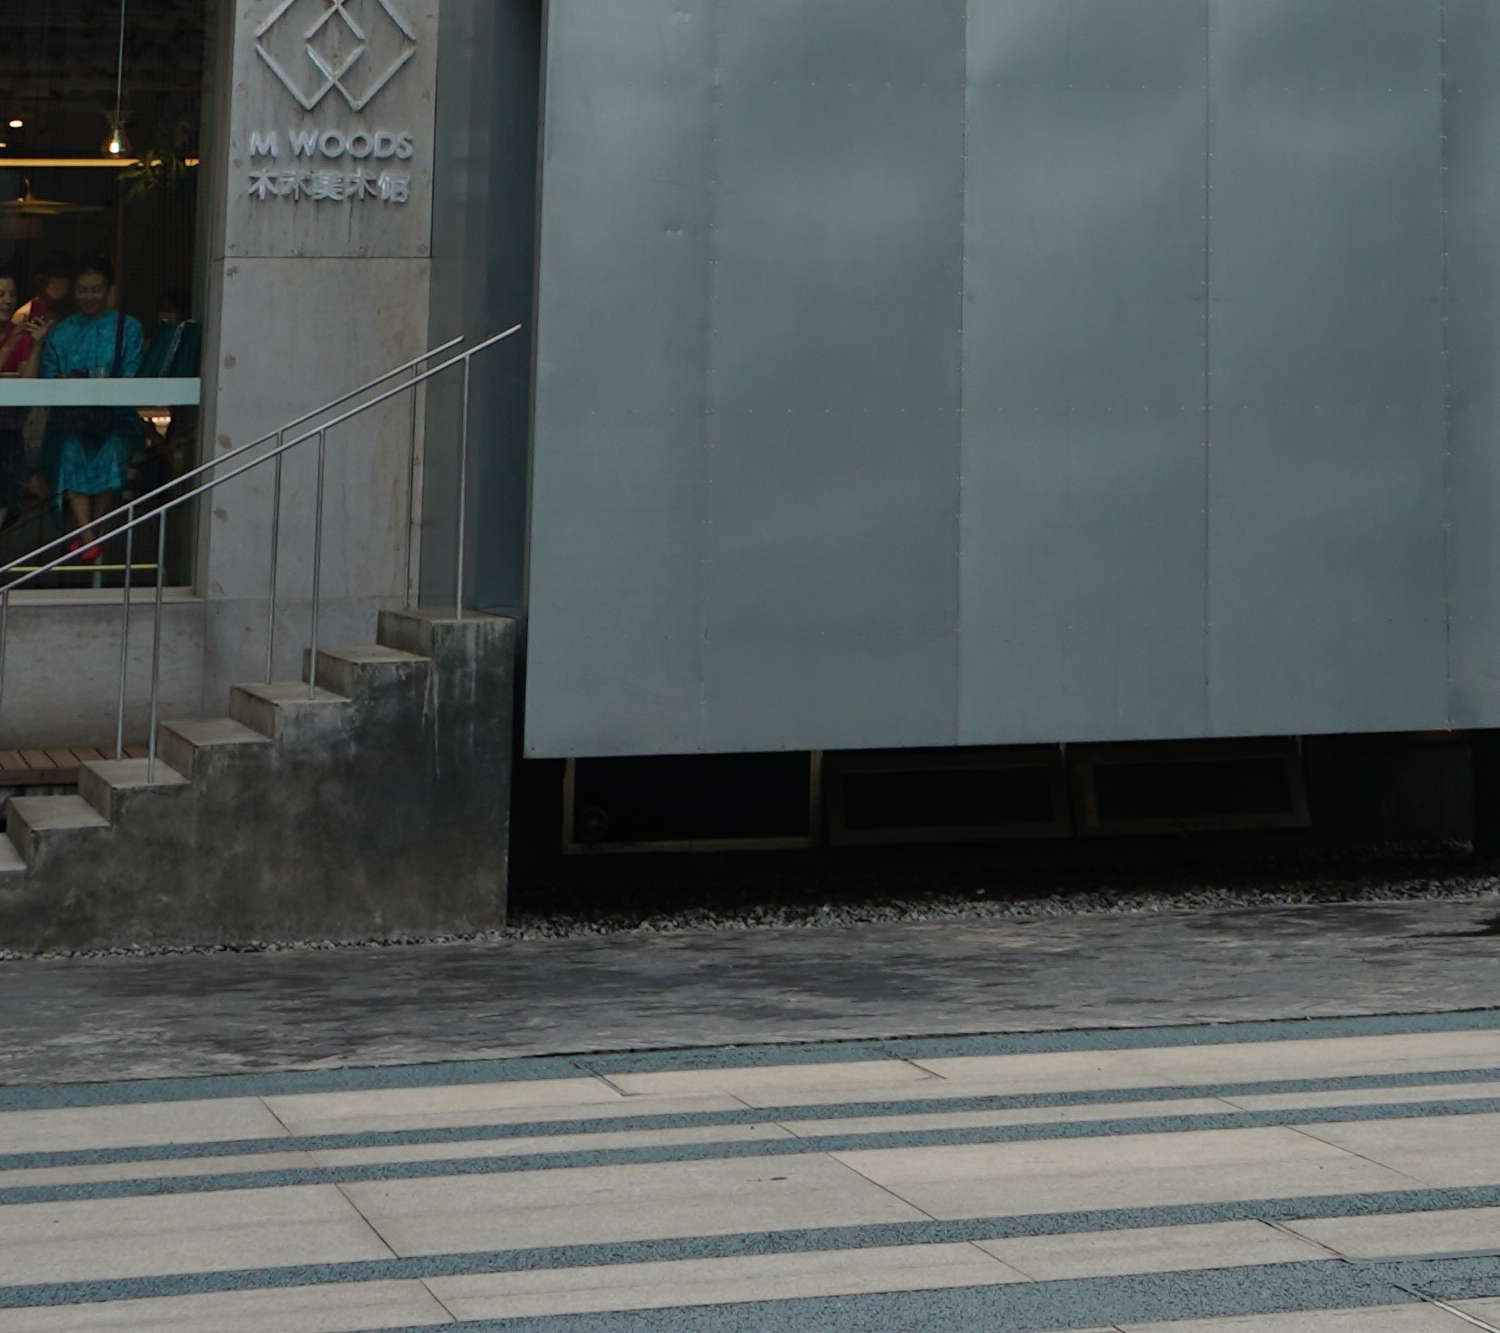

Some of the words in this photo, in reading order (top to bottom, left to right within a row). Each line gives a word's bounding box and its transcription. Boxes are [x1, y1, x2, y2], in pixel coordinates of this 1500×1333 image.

[249, 131, 279, 158] M
[288, 131, 415, 160] WOODS
[247, 166, 412, 205] 木木美术馆
